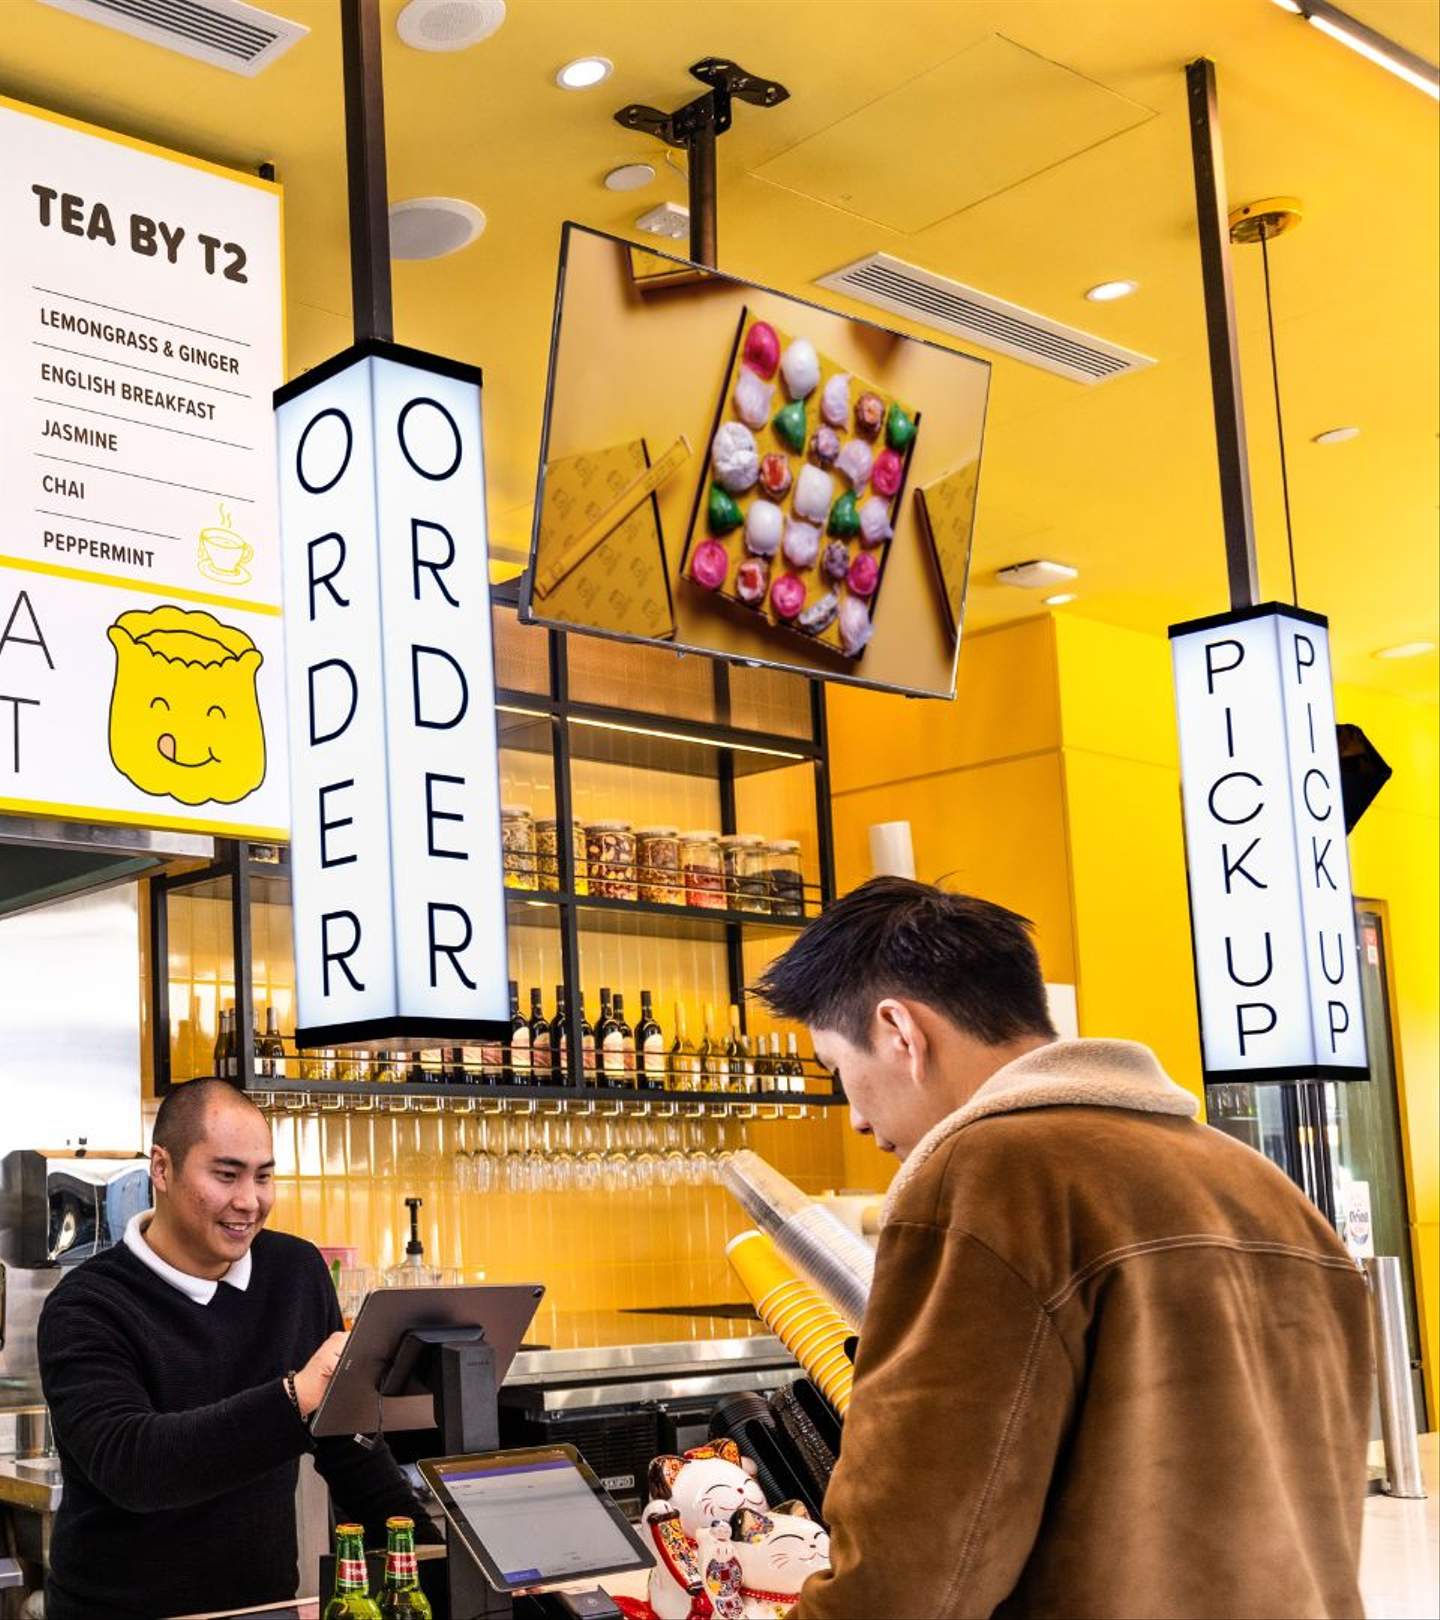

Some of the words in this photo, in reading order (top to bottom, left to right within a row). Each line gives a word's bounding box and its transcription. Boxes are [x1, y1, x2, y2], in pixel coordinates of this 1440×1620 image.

[31, 184, 116, 247] TEA
[129, 213, 186, 265] BY
[197, 233, 248, 284] T2
[40, 307, 158, 354] LEMONGRASS
[162, 340, 174, 358] &
[178, 344, 239, 375] GINGER
[41, 363, 115, 397] ENGLISH
[121, 383, 216, 420] BREAKFAST
[41, 419, 118, 452] JASMINE
[42, 474, 85, 500] CHAI
[43, 530, 155, 568] PEPPERMINT
[296, 407, 366, 997] ORDER
[396, 396, 477, 991] ORDER
